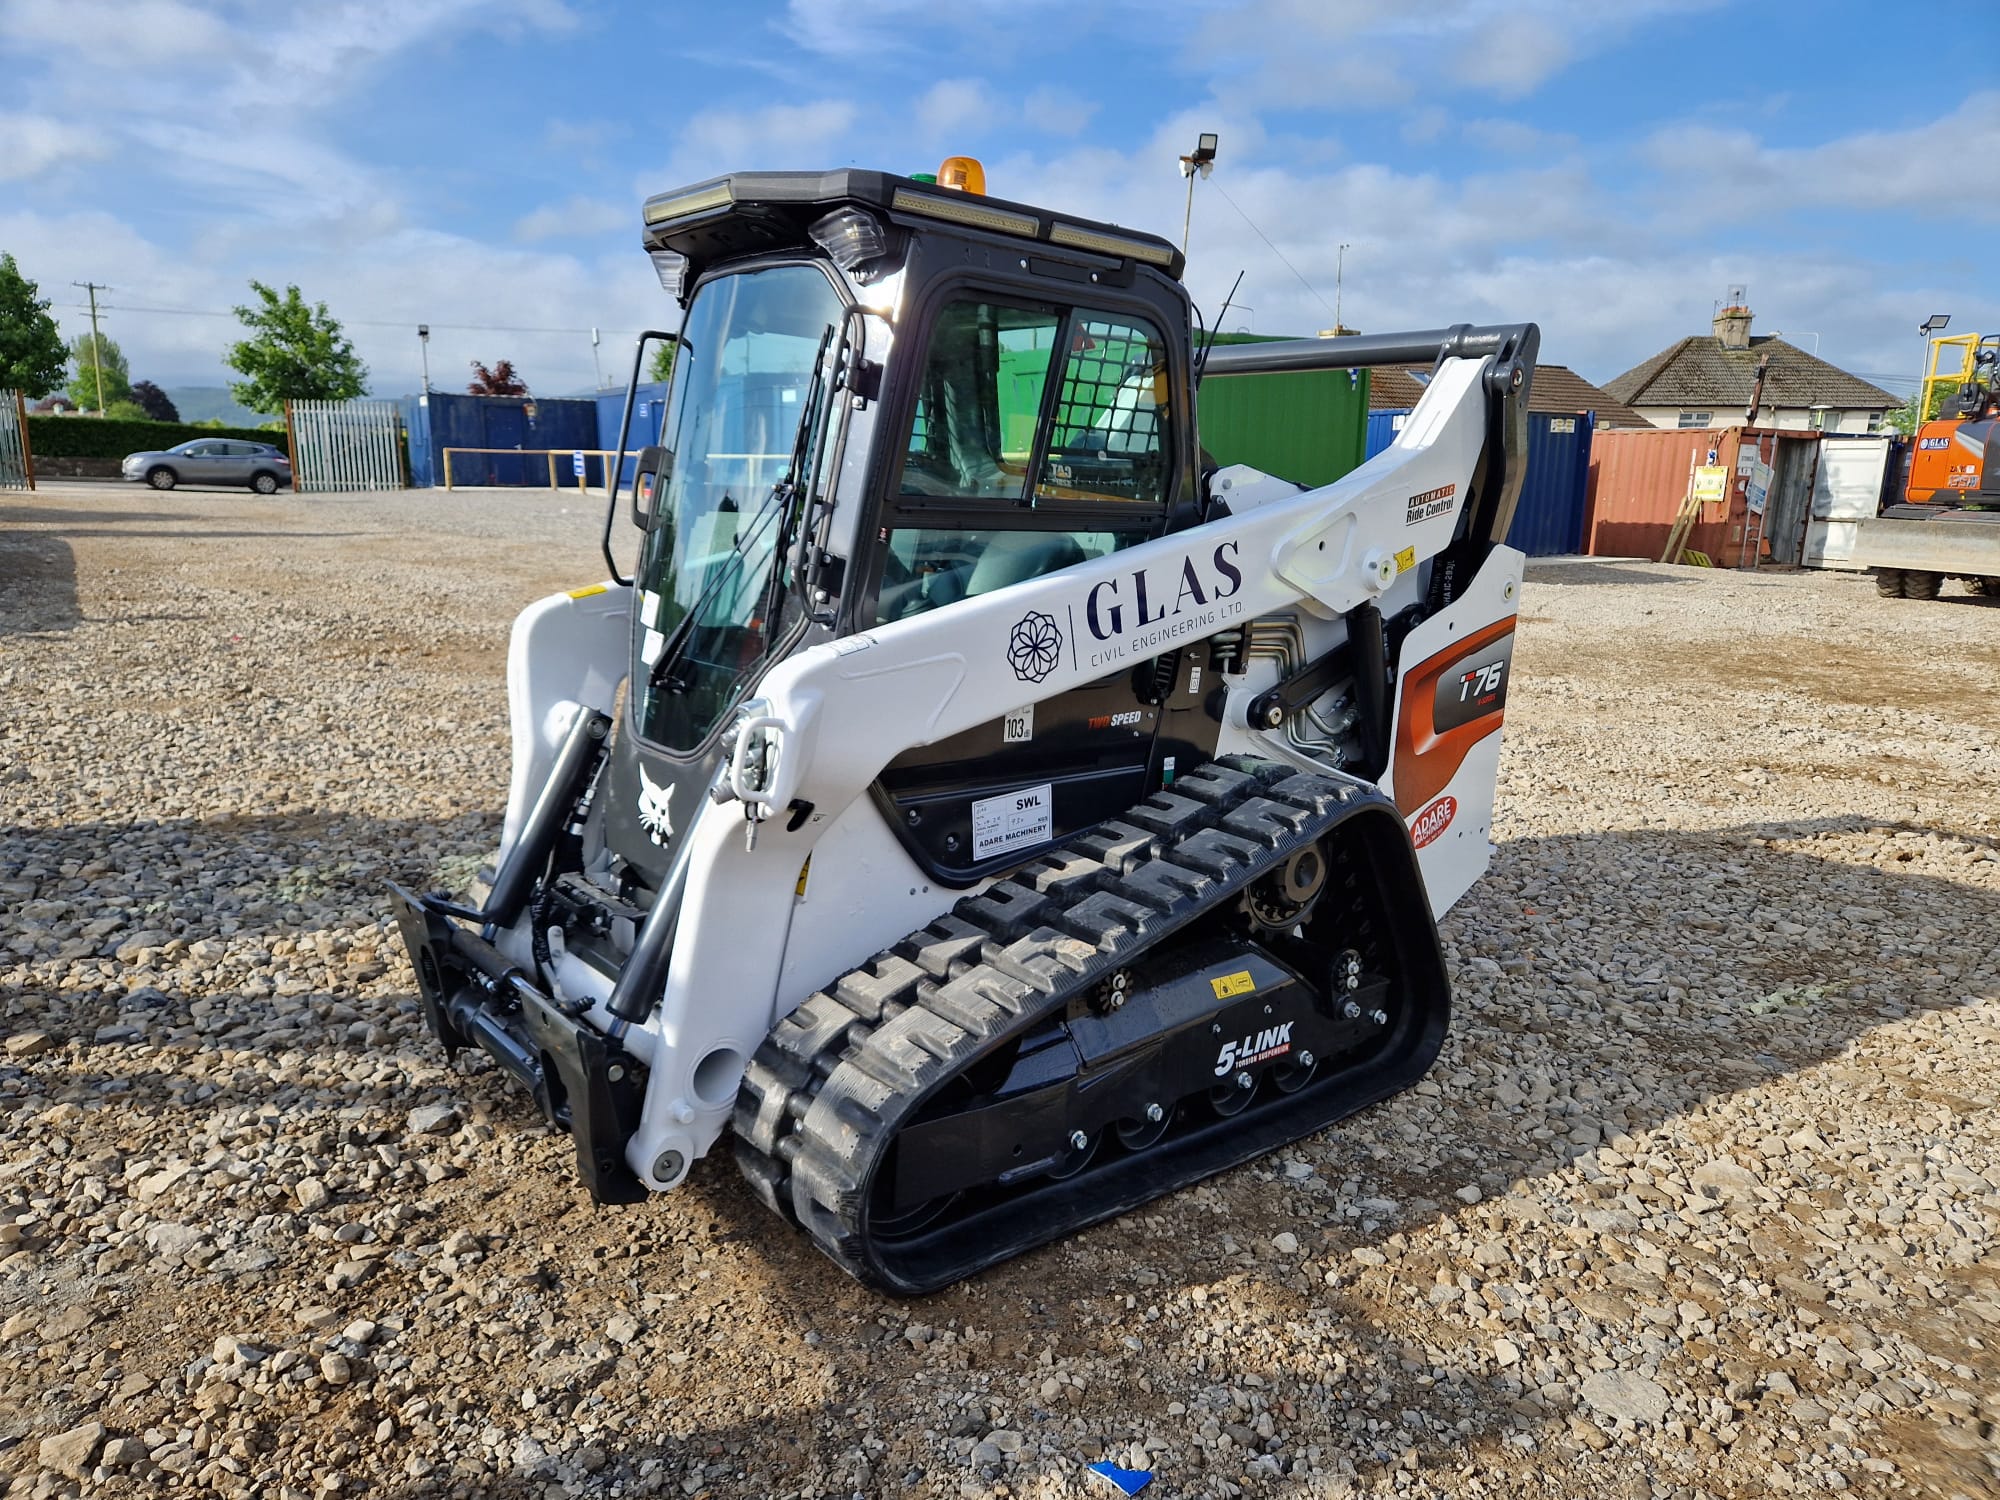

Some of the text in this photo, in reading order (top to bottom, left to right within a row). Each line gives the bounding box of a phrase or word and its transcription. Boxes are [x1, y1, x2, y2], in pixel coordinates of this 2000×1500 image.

[1930, 438, 1950, 447] GLAS
[1409, 484, 1455, 507] AUTOMATIC
[1406, 496, 1454, 523] Ride Control
[1086, 540, 1242, 640] GLAS
[1091, 601, 1246, 667] CIVIL ENGINEERING LTD.
[1460, 661, 1504, 702] T76
[1006, 718, 1024, 739] 103
[1088, 710, 1142, 730] TWO SPEED
[1016, 795, 1041, 811] SWL
[1414, 798, 1451, 839] ADARE
[979, 835, 1003, 848] ADARE
[1005, 824, 1047, 841] MACHINERY
[1214, 1020, 1295, 1077] 5-LINK
[1235, 1044, 1289, 1069] TORSION SUSPENSION
